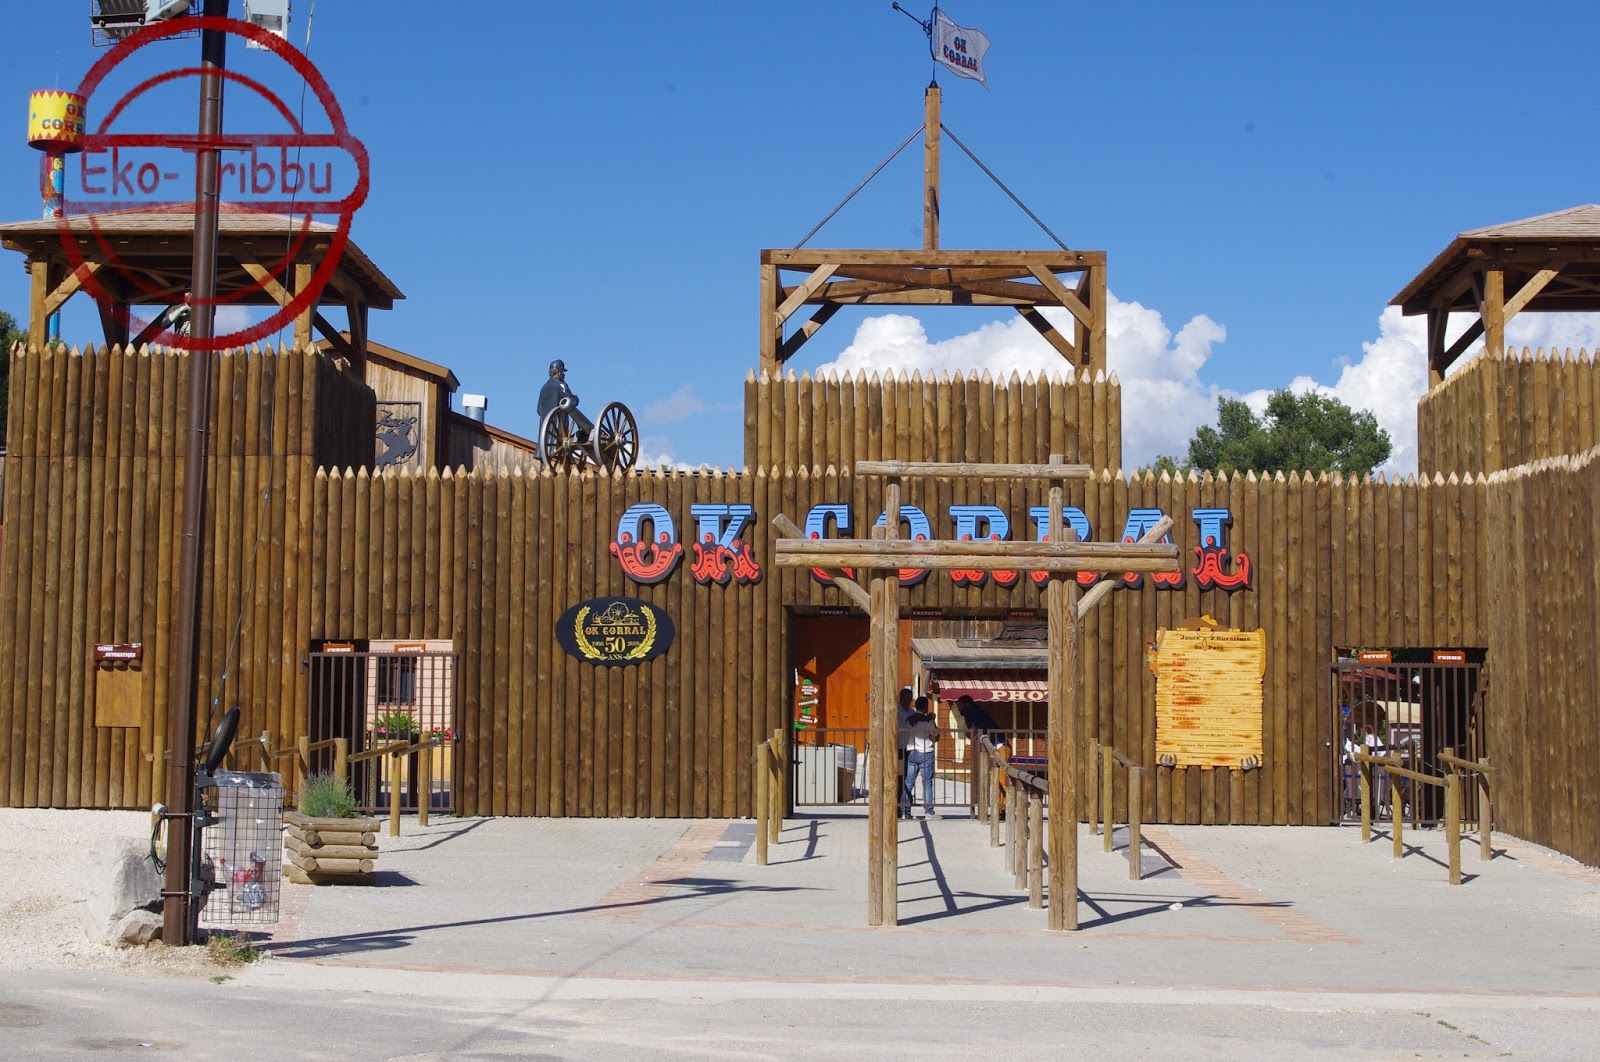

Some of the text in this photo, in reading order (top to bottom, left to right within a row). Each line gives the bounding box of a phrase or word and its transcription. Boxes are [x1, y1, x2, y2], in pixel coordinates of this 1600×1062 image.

[953, 36, 967, 54] OK
[943, 44, 978, 72] CORRAL
[609, 502, 764, 585] OK
[585, 626, 646, 635] OK CORRAL
[604, 636, 626, 653] 50
[990, 690, 1049, 700] PHO
